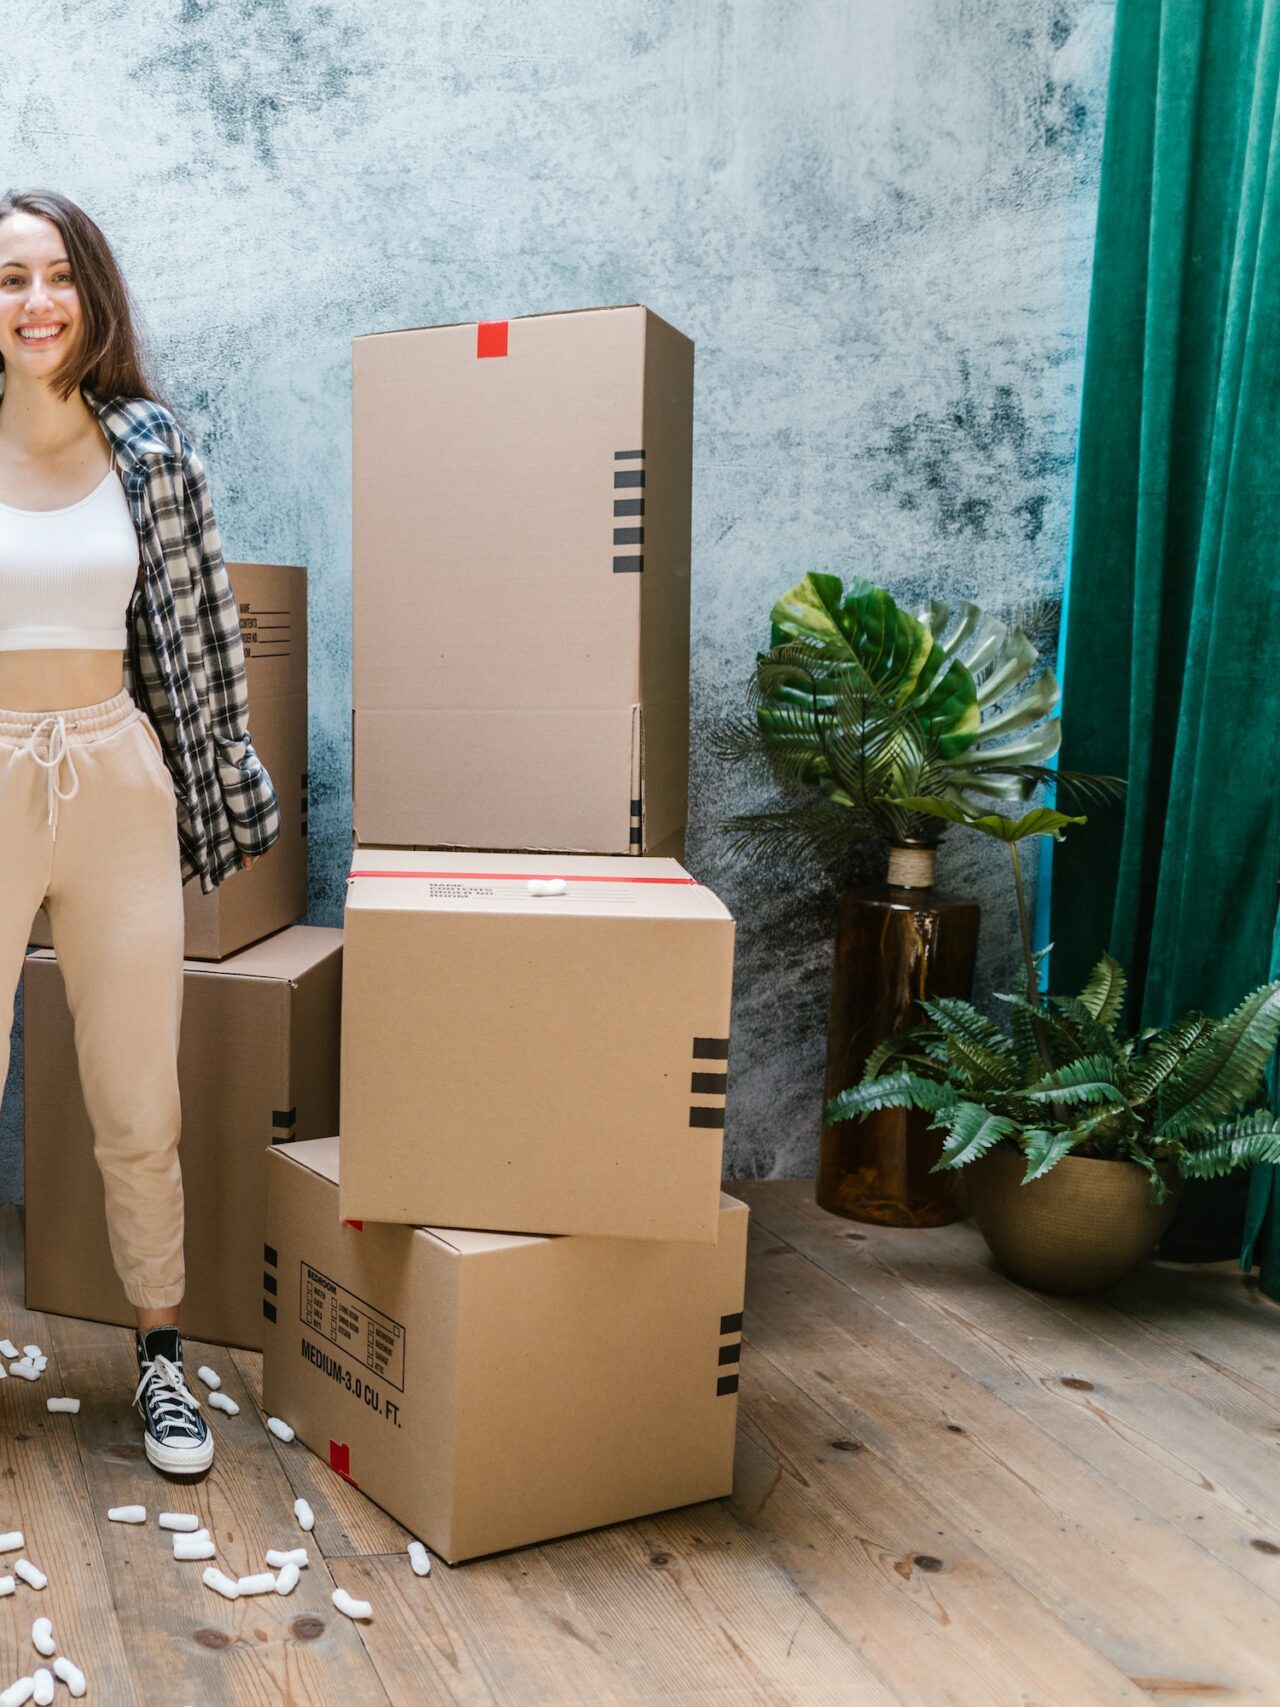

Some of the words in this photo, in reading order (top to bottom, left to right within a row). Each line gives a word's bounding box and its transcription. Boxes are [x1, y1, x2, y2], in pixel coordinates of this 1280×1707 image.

[307, 1269, 337, 1296] BEDROOM
[364, 1384, 382, 1414] CU.
[385, 1399, 401, 1428] FT.
